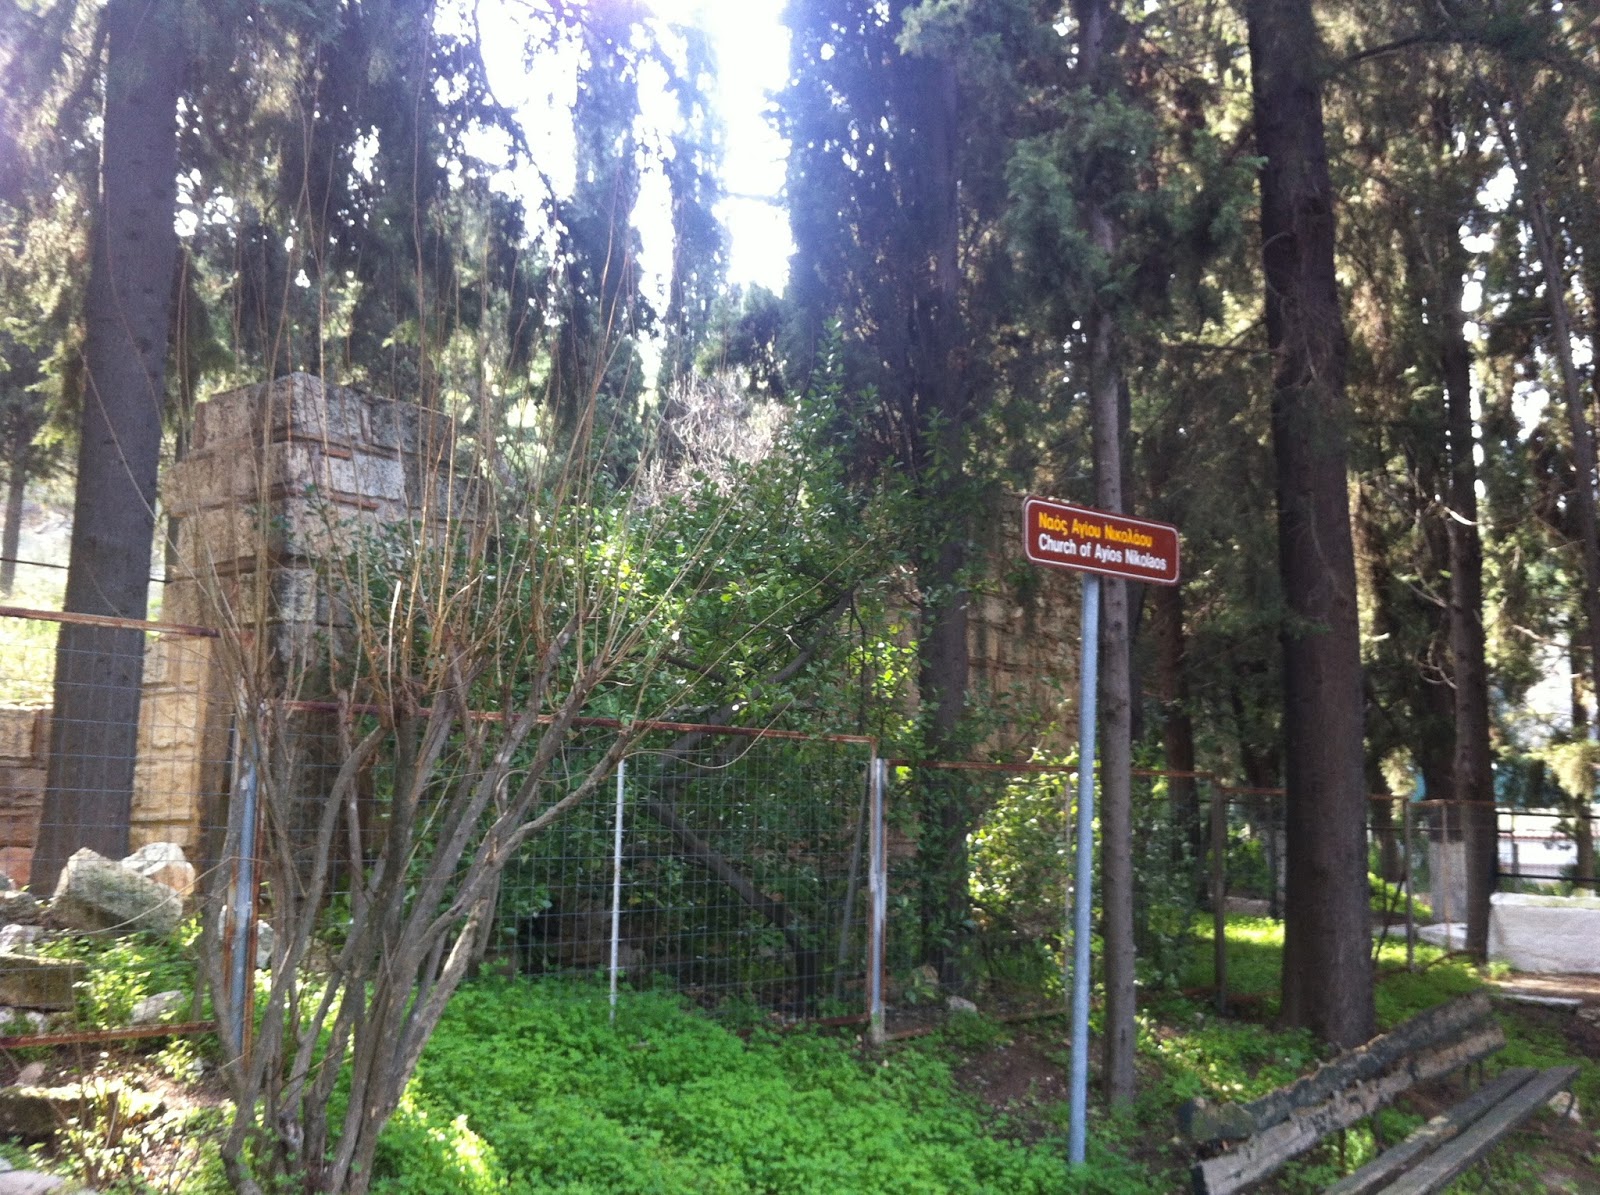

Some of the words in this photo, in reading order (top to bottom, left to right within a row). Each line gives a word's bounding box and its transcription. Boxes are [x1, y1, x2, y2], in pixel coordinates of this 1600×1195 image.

[1039, 511, 1068, 536] Ναός
[1038, 533, 1077, 555] Church
[1079, 542, 1092, 557] of
[1094, 543, 1122, 563] Ayios
[1125, 548, 1167, 571] Nikolaos
